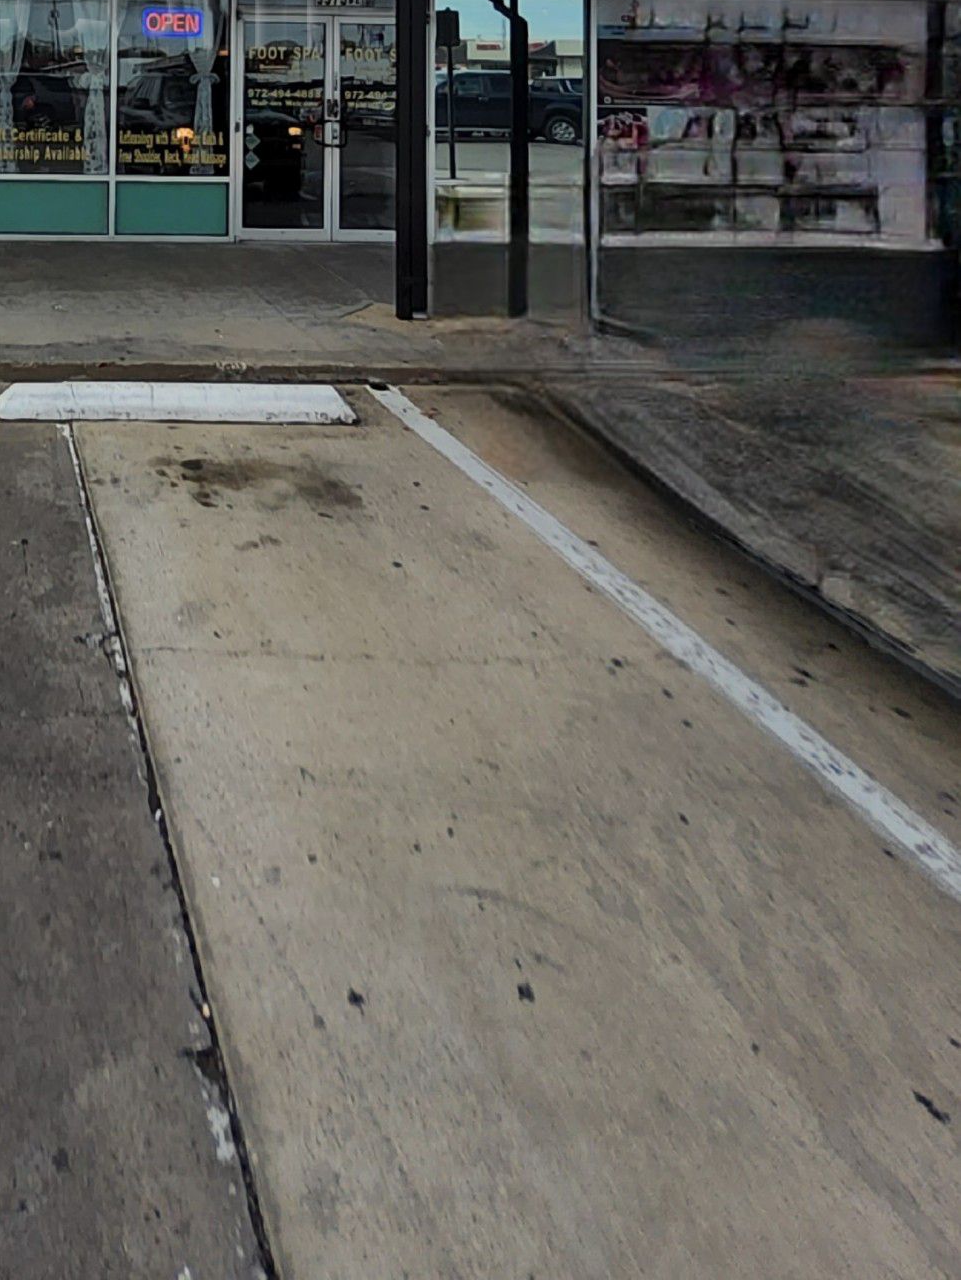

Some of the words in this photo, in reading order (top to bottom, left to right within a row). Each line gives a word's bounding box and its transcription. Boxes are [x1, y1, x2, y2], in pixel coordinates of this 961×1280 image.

[145, 12, 200, 34] OPEN
[248, 46, 287, 61] FOOT
[292, 46, 321, 61] SPA
[345, 47, 383, 62] FOOT
[11, 127, 70, 141] Certificate
[74, 127, 83, 141] &
[44, 145, 90, 161] Available
